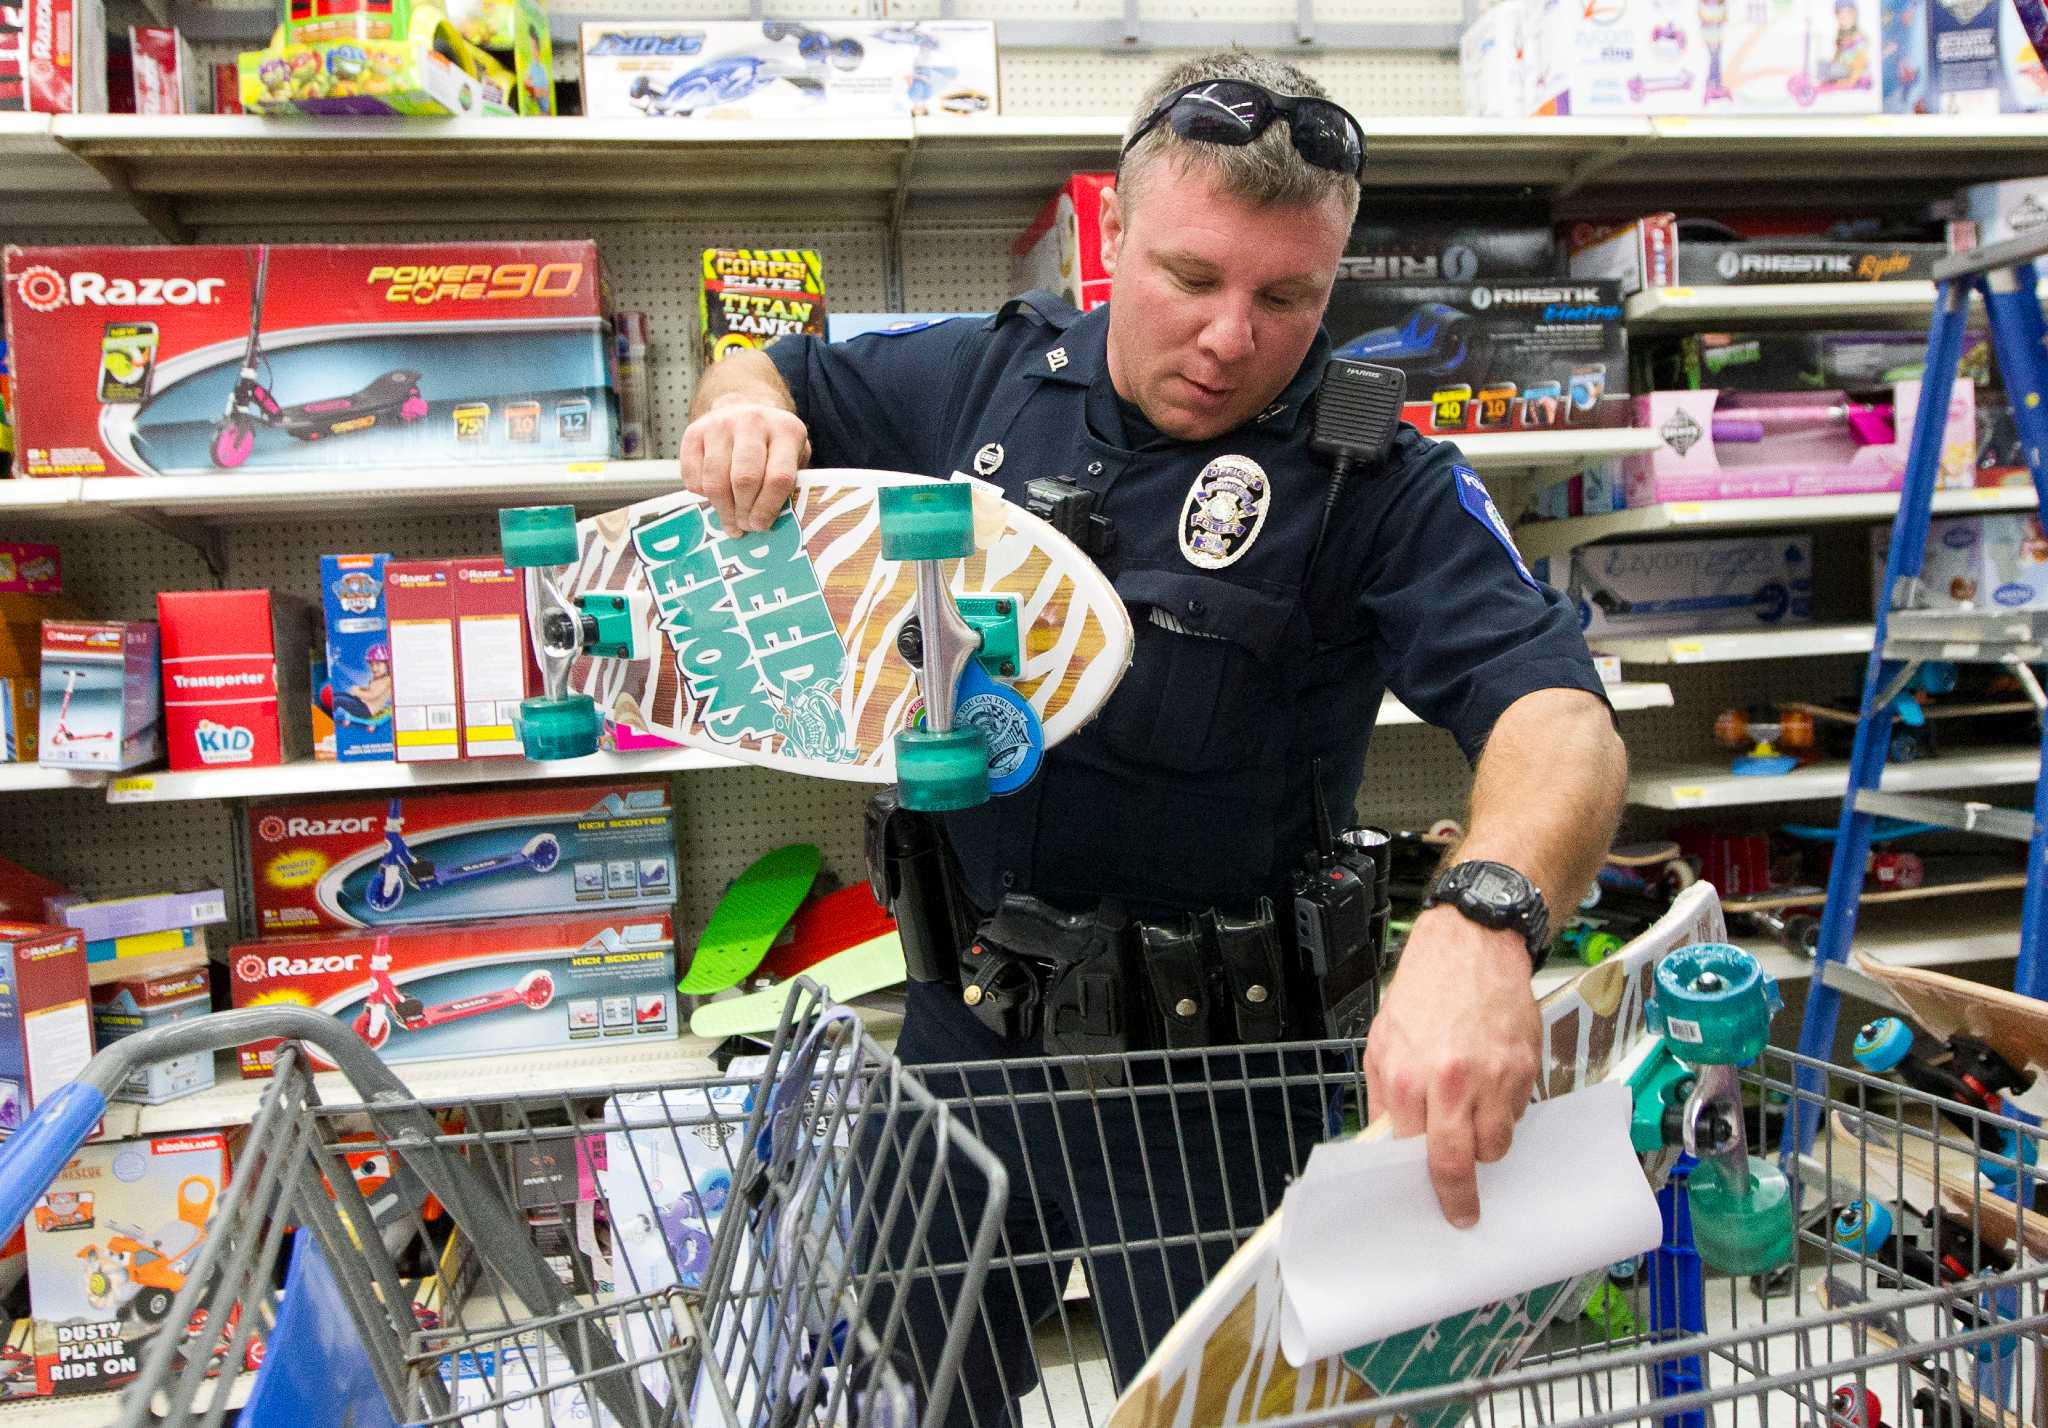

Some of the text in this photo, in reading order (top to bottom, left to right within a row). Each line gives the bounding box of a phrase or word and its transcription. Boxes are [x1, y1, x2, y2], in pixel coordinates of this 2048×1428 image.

[716, 258, 807, 279] CORPS!
[1742, 255, 1854, 273] RIPSTIK
[69, 272, 226, 305] Razor
[367, 263, 583, 298] POWER 90
[723, 275, 802, 291] ELITE
[385, 282, 487, 304] CORE
[1493, 288, 1600, 303] RIPSTIK
[719, 292, 812, 322] TITAN
[725, 313, 804, 336] TANK!
[1346, 367, 1381, 379] HARRIS
[1438, 401, 1461, 416] 40
[564, 415, 584, 428] 12
[708, 505, 847, 697] PEED
[636, 503, 778, 738] DEMONS
[172, 672, 265, 690] Transporter
[960, 695, 1022, 717] YOU CAN TRUST
[199, 729, 250, 752] KID
[287, 816, 377, 838] Razor
[608, 816, 667, 828] SCOOTER
[264, 954, 361, 977] Razor
[572, 950, 665, 966] KICK SCOOTER
[58, 1322, 122, 1342] DUSTY
[58, 1340, 124, 1361] PLANE
[50, 1356, 137, 1381] RIDE ON
